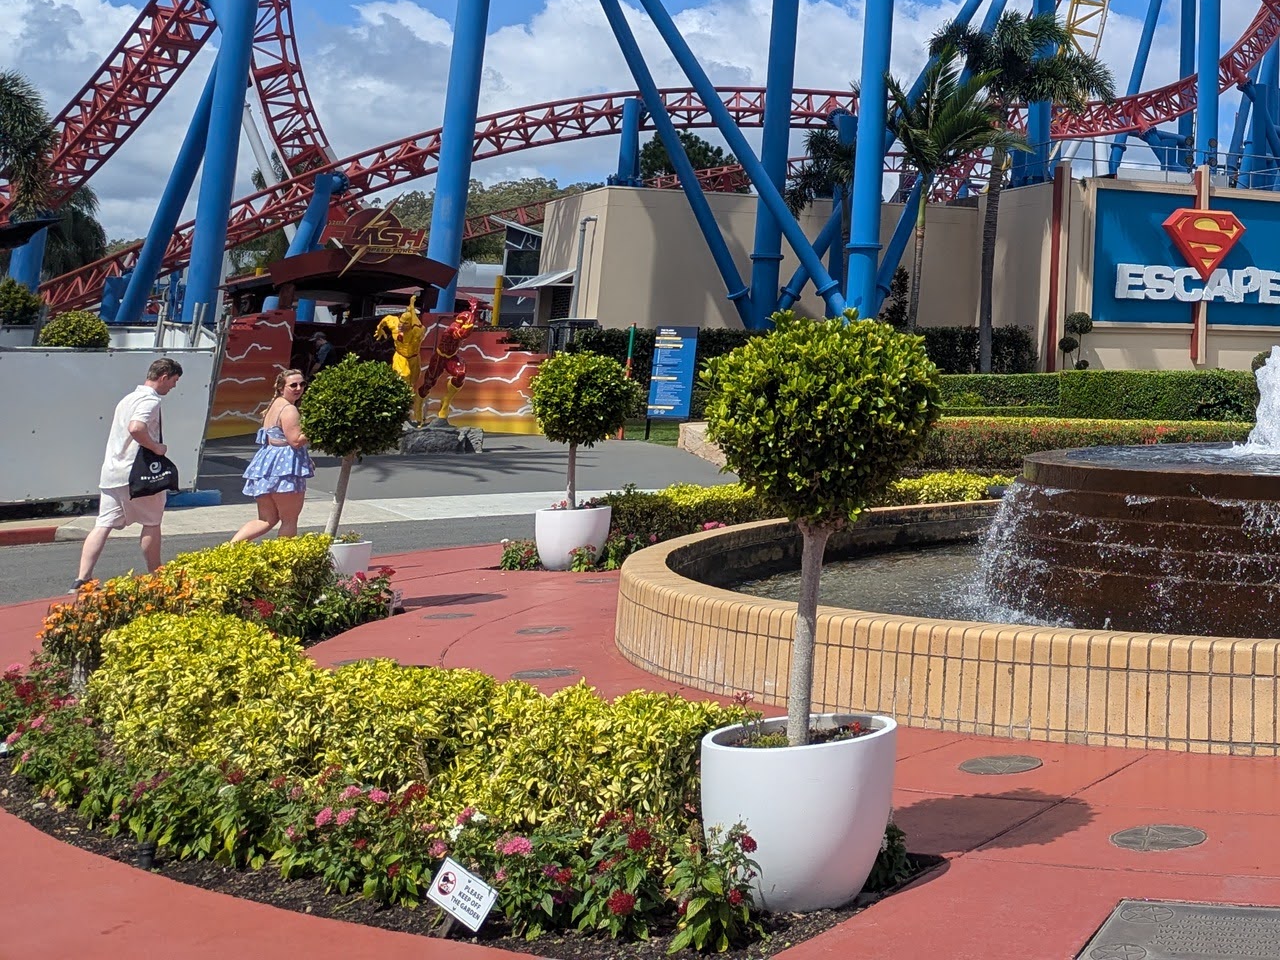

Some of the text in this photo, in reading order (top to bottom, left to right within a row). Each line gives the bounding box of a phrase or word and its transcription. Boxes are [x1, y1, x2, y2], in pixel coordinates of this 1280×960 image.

[318, 224, 426, 249] FLASH
[458, 891, 481, 910] KEEP OFF
[464, 885, 483, 901] PLEASE
[451, 895, 480, 920] THE GARDEN
